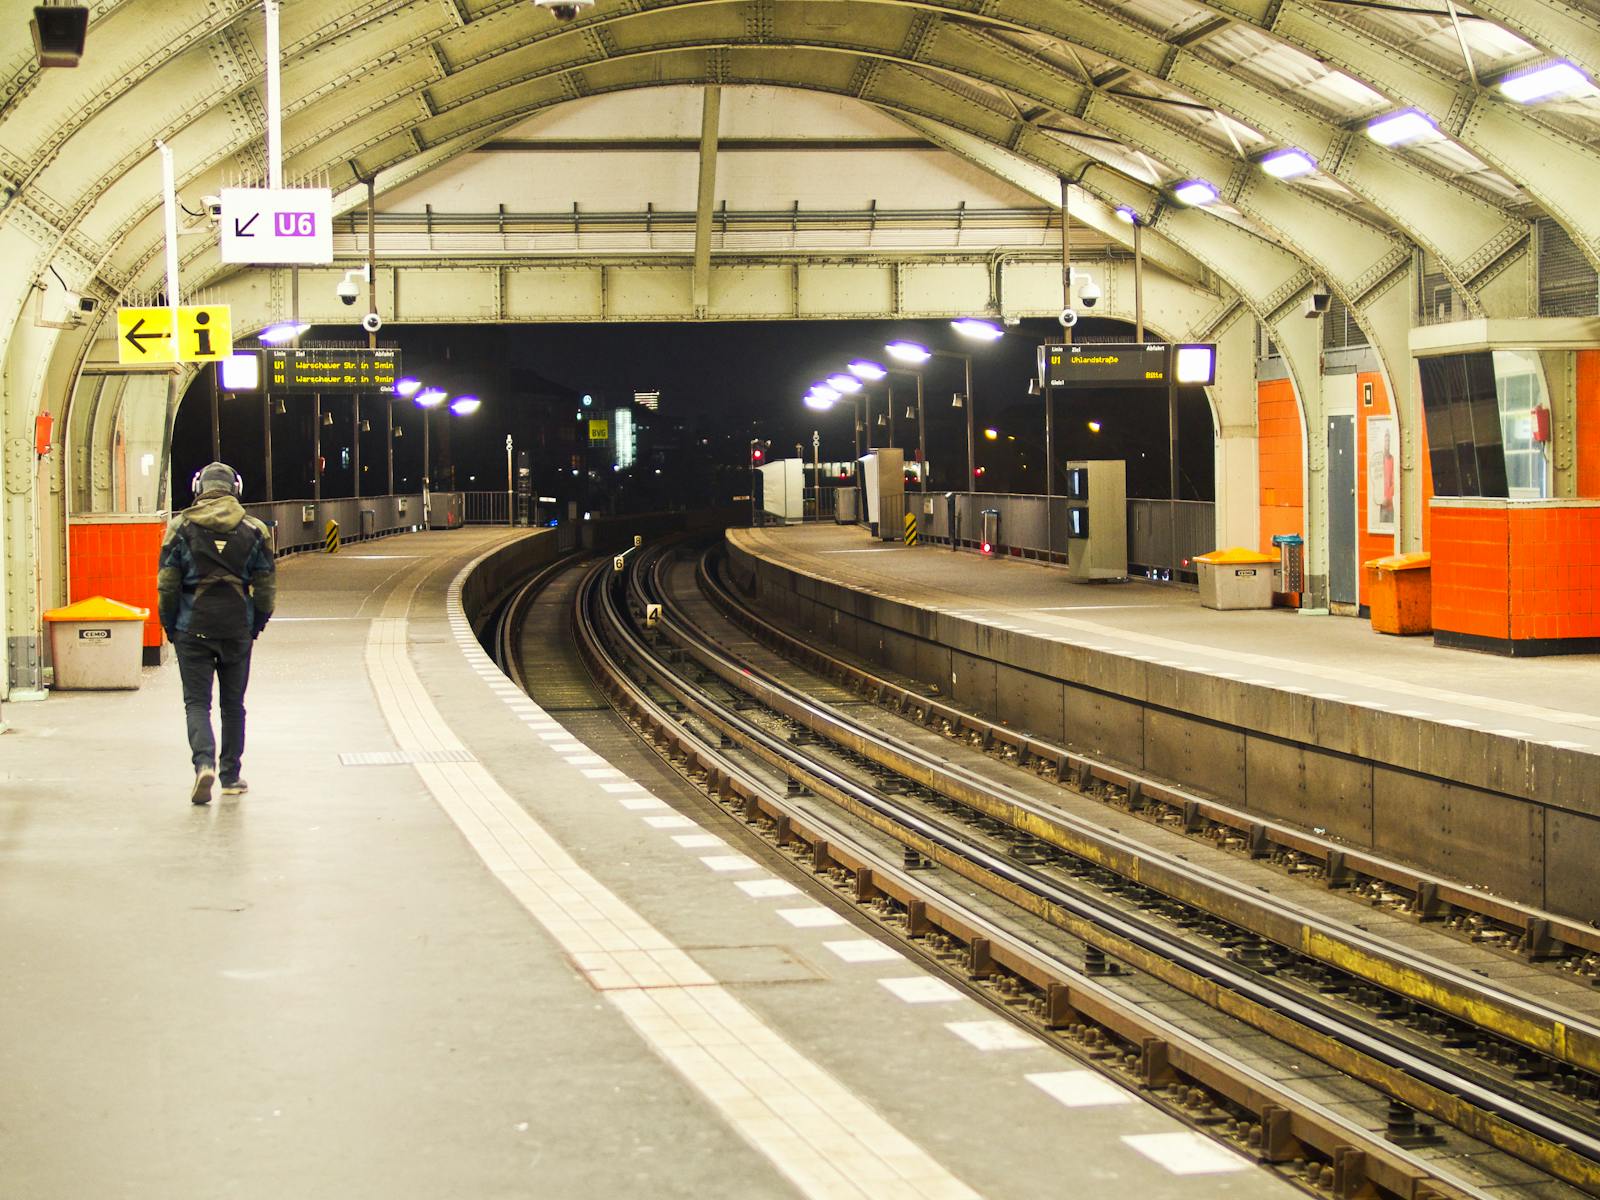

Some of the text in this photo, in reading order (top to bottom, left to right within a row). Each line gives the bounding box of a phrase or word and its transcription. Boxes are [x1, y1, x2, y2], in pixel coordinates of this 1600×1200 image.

[278, 213, 312, 235] U6
[274, 361, 284, 369] U1
[295, 361, 341, 369] Warschauer
[343, 361, 357, 369] Str.
[360, 361, 369, 369] in
[1051, 356, 1119, 364] U1 Uhlandstraße
[274, 375, 284, 383] U1
[295, 375, 341, 383] Warschauer
[343, 375, 357, 383] Str.
[360, 375, 369, 383] in
[591, 428, 607, 438] BVG
[615, 559, 623, 569] 6
[648, 607, 659, 620] 4
